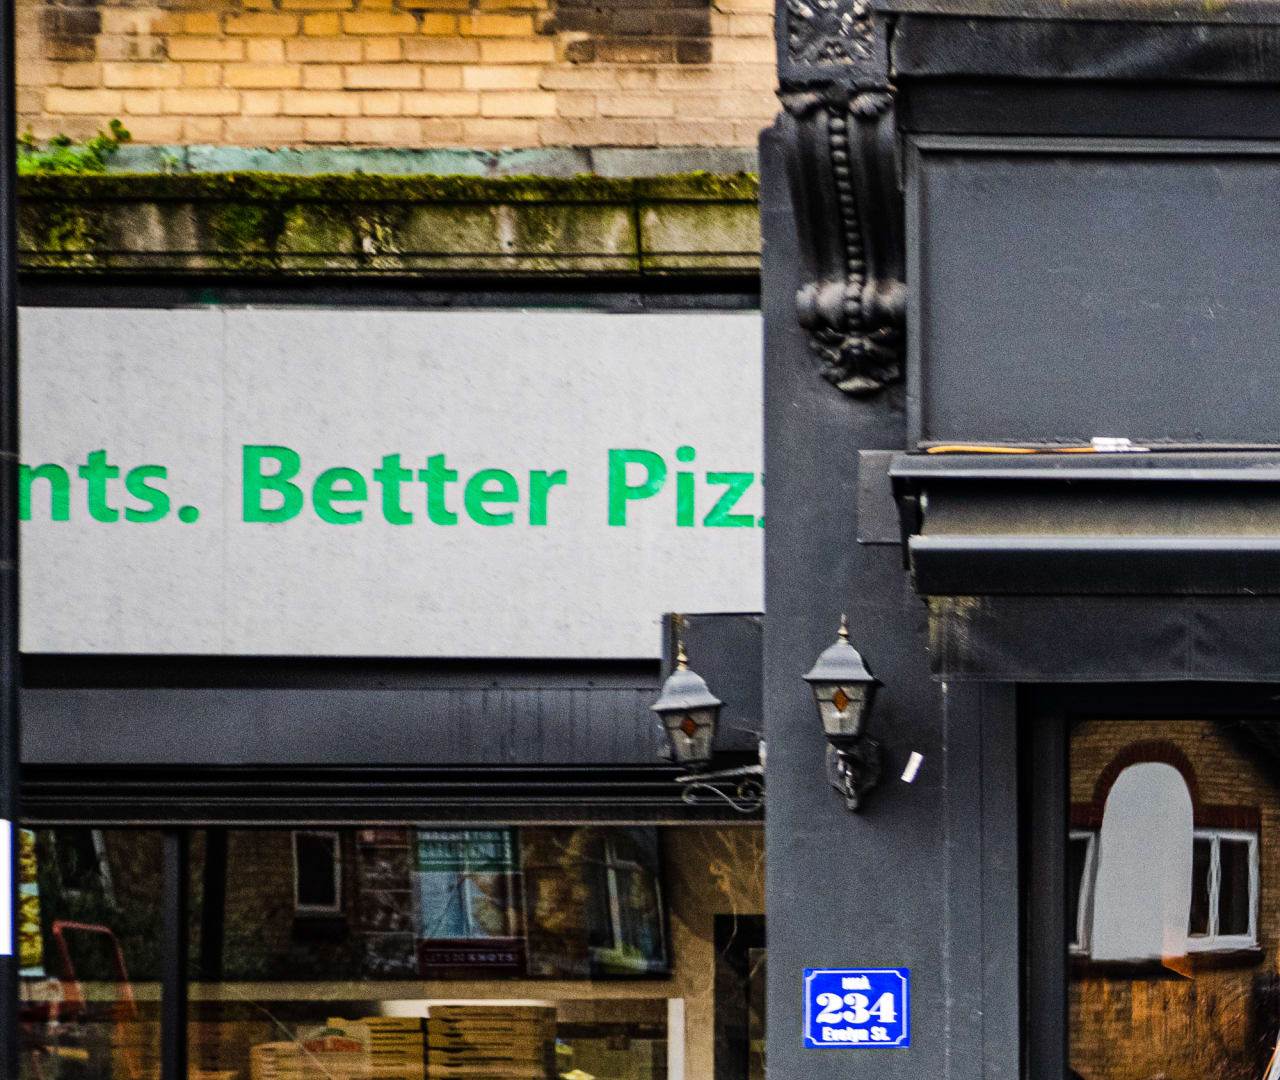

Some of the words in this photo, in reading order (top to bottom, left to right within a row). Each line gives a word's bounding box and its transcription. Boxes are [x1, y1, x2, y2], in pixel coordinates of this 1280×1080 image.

[18, 449, 200, 524] nts.
[241, 444, 568, 528] Better
[607, 445, 765, 529] Piz
[815, 992, 897, 1024] 234
